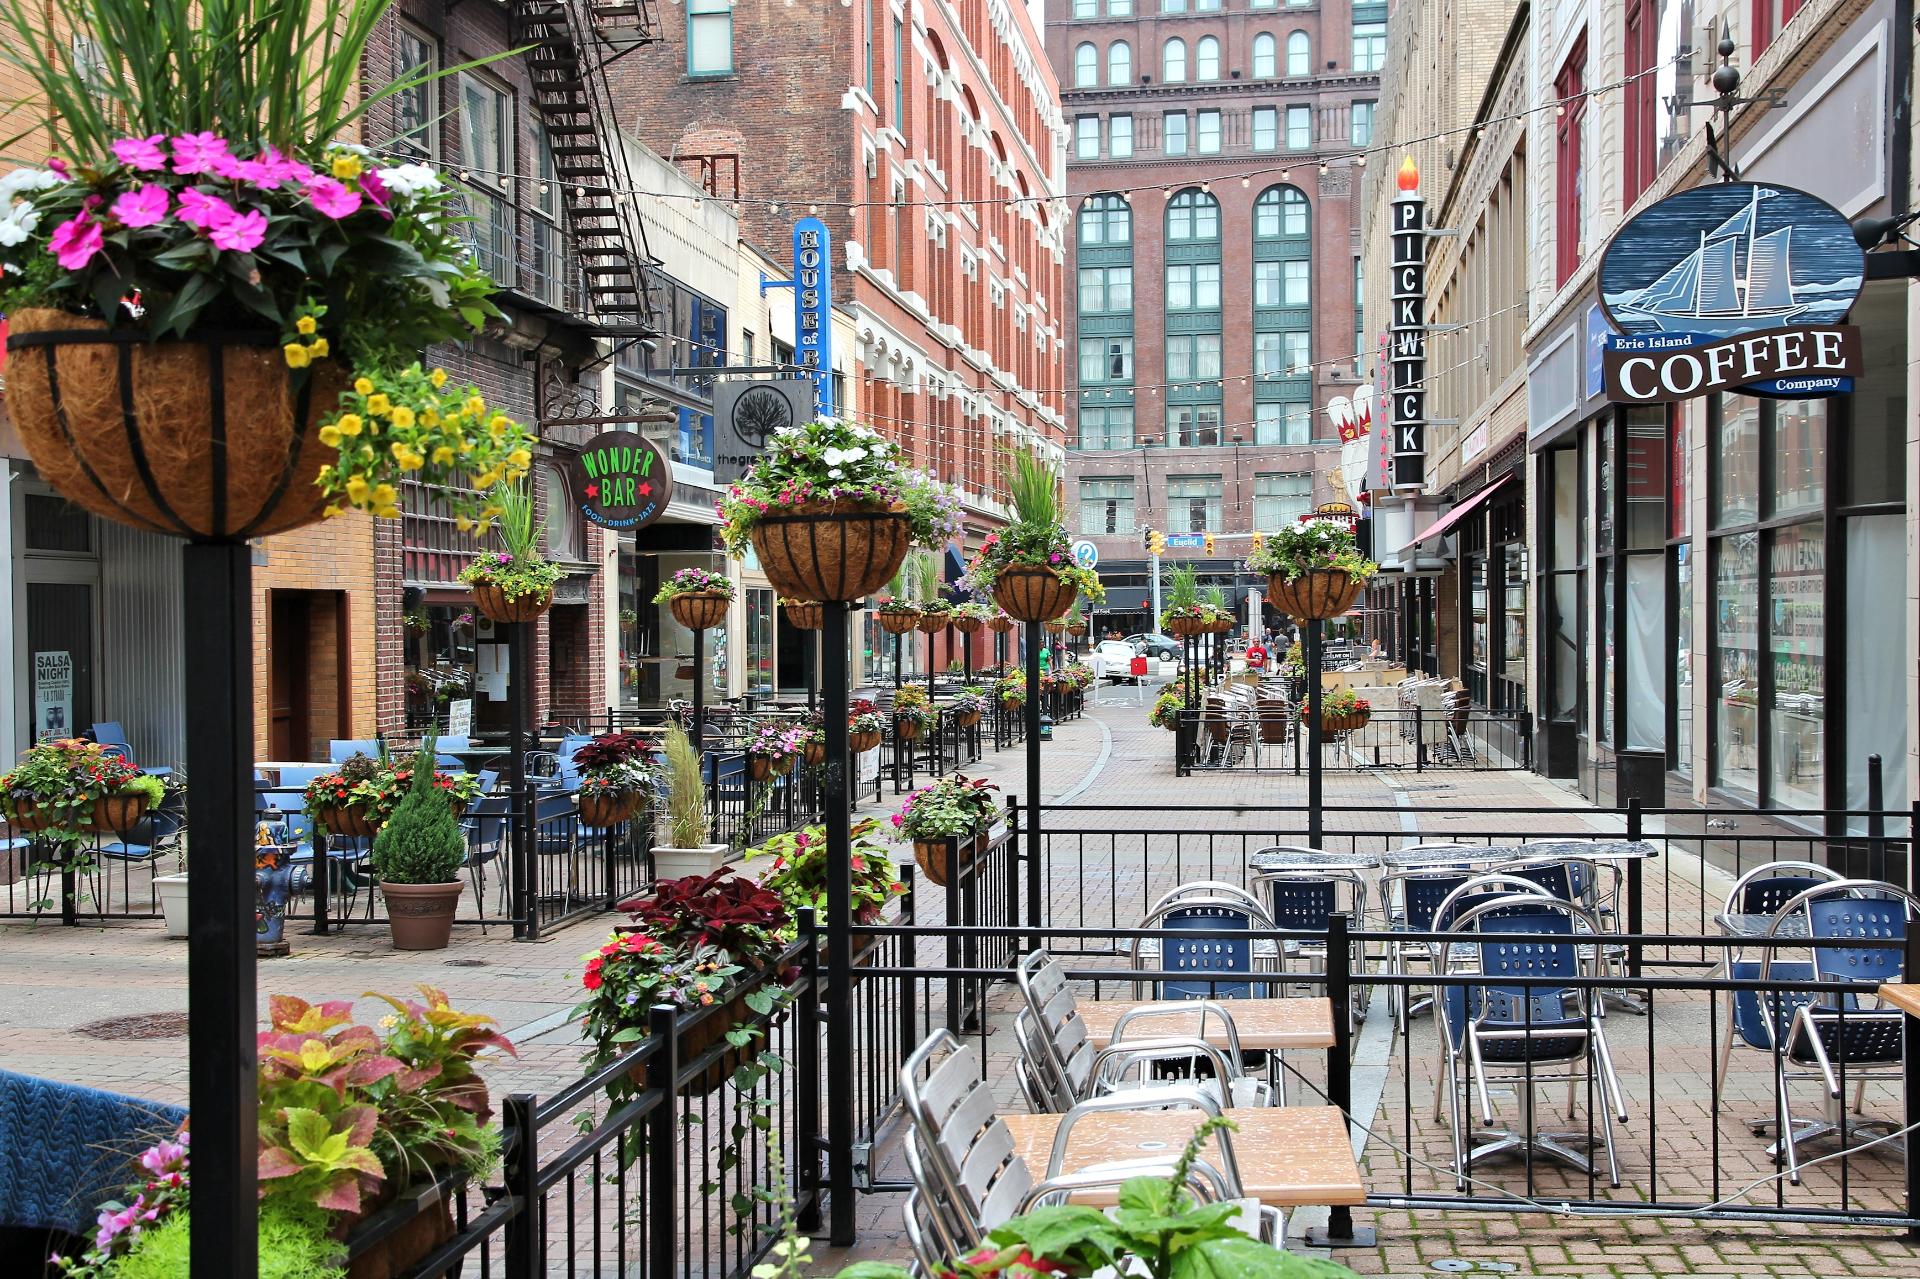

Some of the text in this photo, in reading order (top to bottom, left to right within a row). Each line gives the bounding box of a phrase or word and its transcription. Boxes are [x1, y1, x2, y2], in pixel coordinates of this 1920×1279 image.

[1768, 87, 1788, 108] E
[799, 230, 820, 330] HOUSE
[802, 332, 818, 345] of
[1399, 203, 1420, 451] PICKWICK
[1615, 338, 1646, 349] Erie
[1648, 335, 1692, 348] Island
[1619, 331, 1846, 399] COFFEE
[1775, 377, 1841, 392] Company
[1379, 333, 1388, 486] RESTAURANT
[581, 447, 654, 479] WONDER
[601, 477, 636, 507] BAR
[581, 502, 656, 527] FOOD DRINK JAZZ
[1173, 538, 1198, 546] Euclid
[1771, 543, 1791, 573] NOW
[37, 655, 70, 668] SALSA
[37, 667, 70, 680] NIGHT
